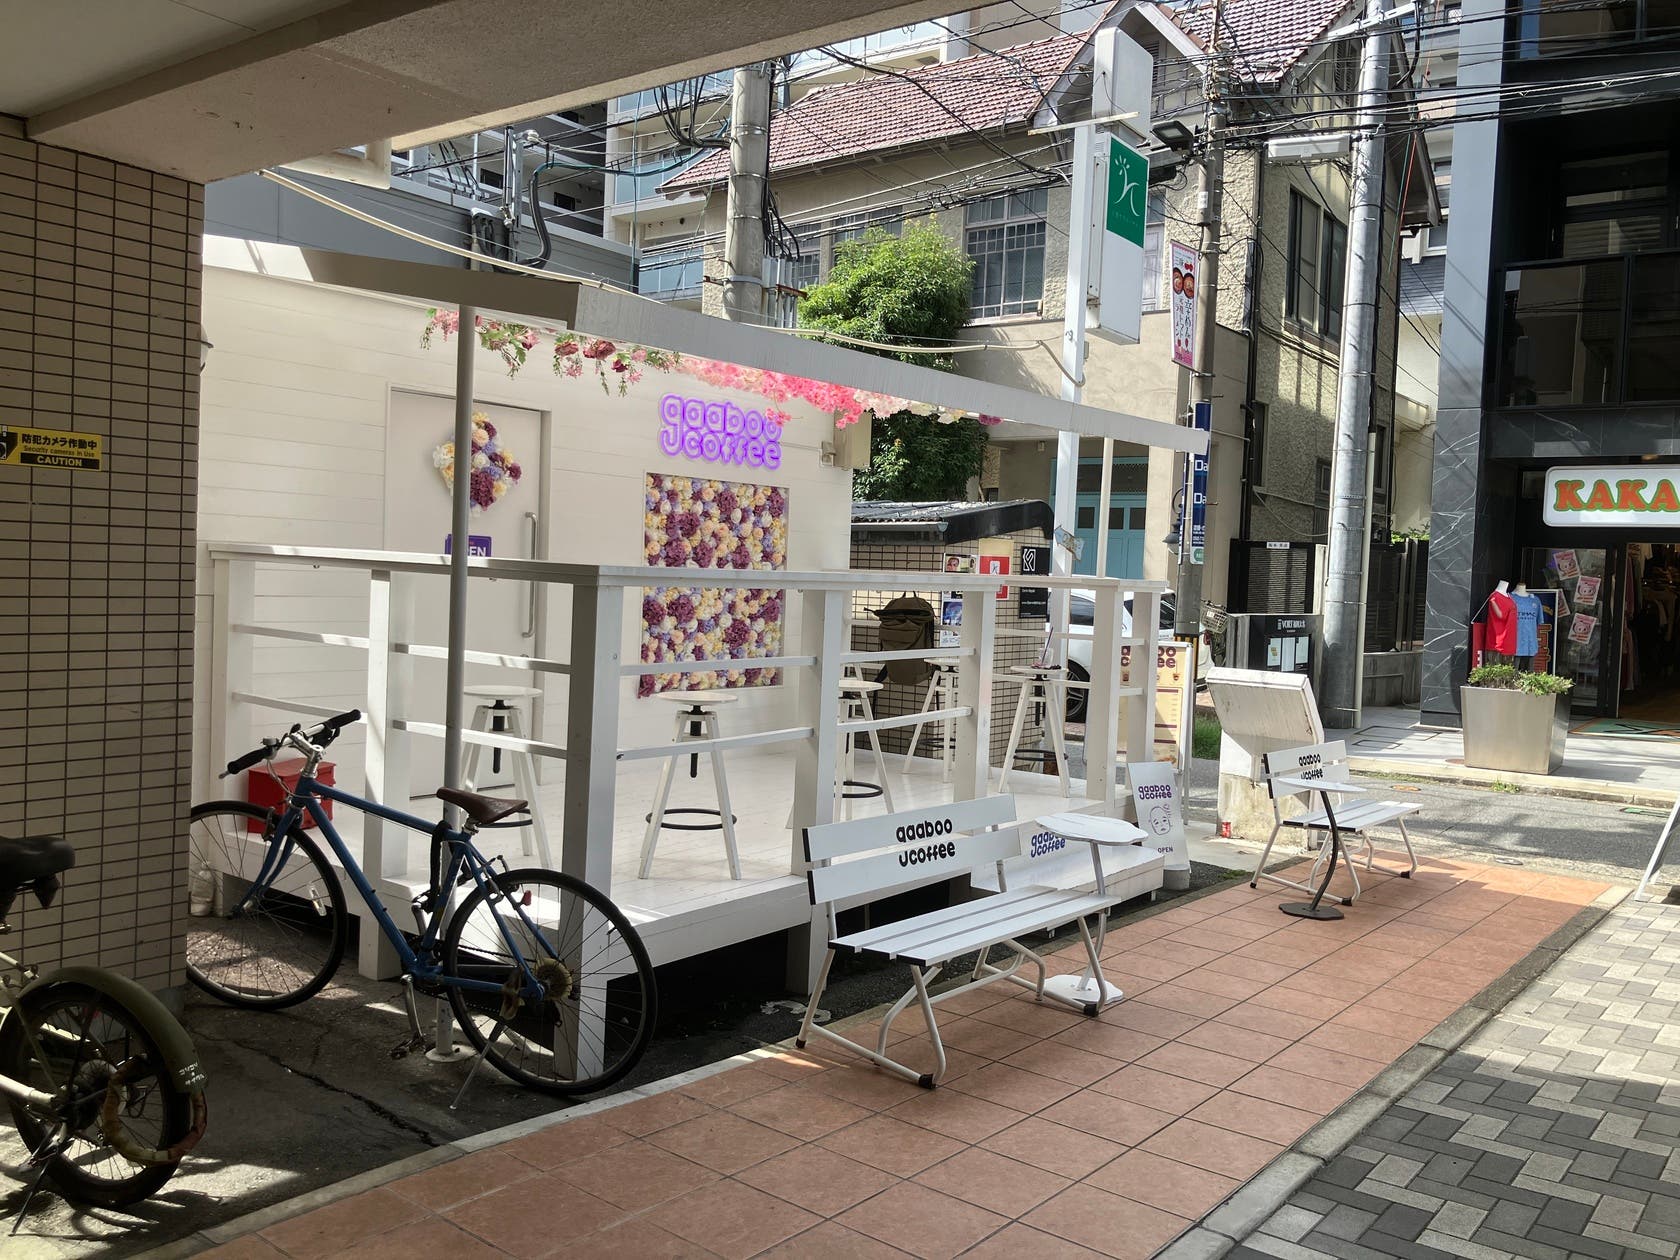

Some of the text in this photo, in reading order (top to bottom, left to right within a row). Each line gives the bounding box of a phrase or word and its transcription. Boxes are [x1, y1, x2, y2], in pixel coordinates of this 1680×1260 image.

[22, 433, 98, 450] 防犯カメラ作動中
[682, 426, 782, 470] coffee
[37, 455, 82, 467] CAUTION
[1553, 478, 1680, 512] KAKA
[1138, 784, 1171, 800] gaaboo
[1145, 791, 1172, 800] coffee
[909, 842, 956, 865] coffee
[1036, 838, 1066, 856] coffee
